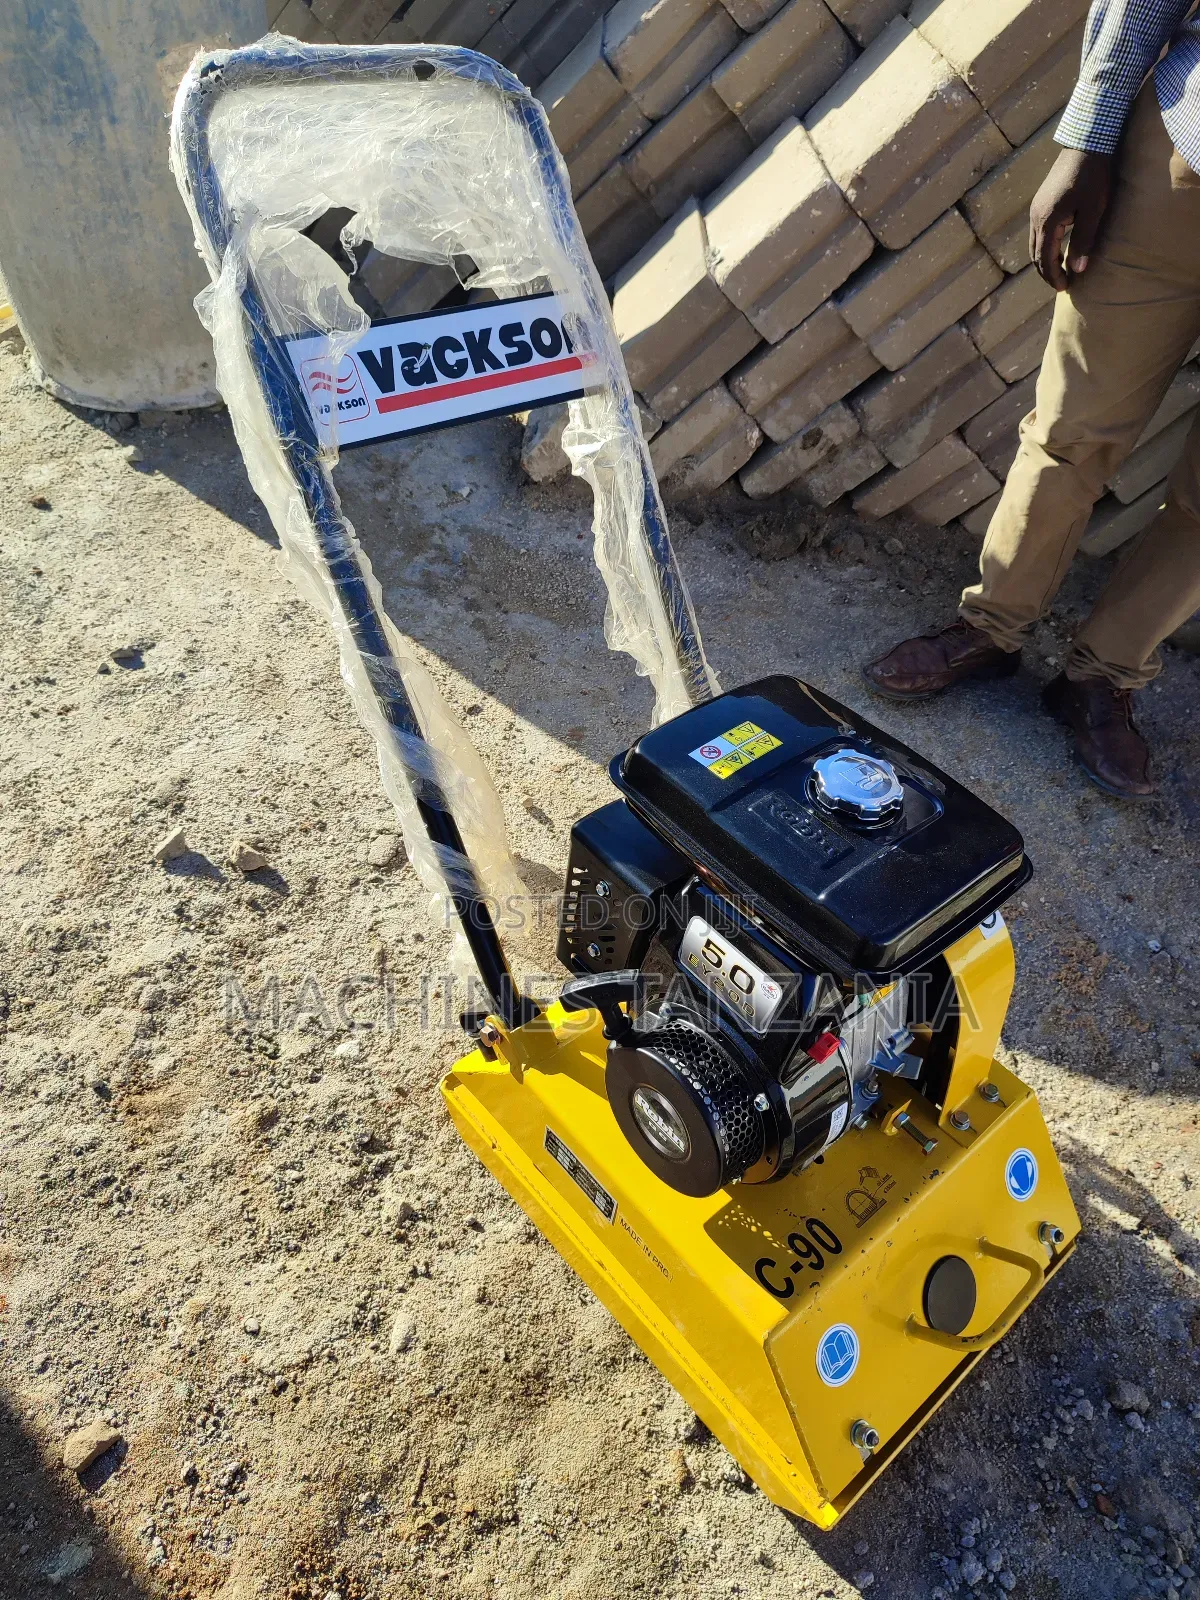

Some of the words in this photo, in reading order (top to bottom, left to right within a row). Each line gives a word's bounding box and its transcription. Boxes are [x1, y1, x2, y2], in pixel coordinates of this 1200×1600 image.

[701, 937, 756, 996] 5.0
[635, 1093, 685, 1151] Robin
[620, 1218, 643, 1247] MADE
[642, 1245, 652, 1257] IN
[754, 1217, 843, 1299] C-90
